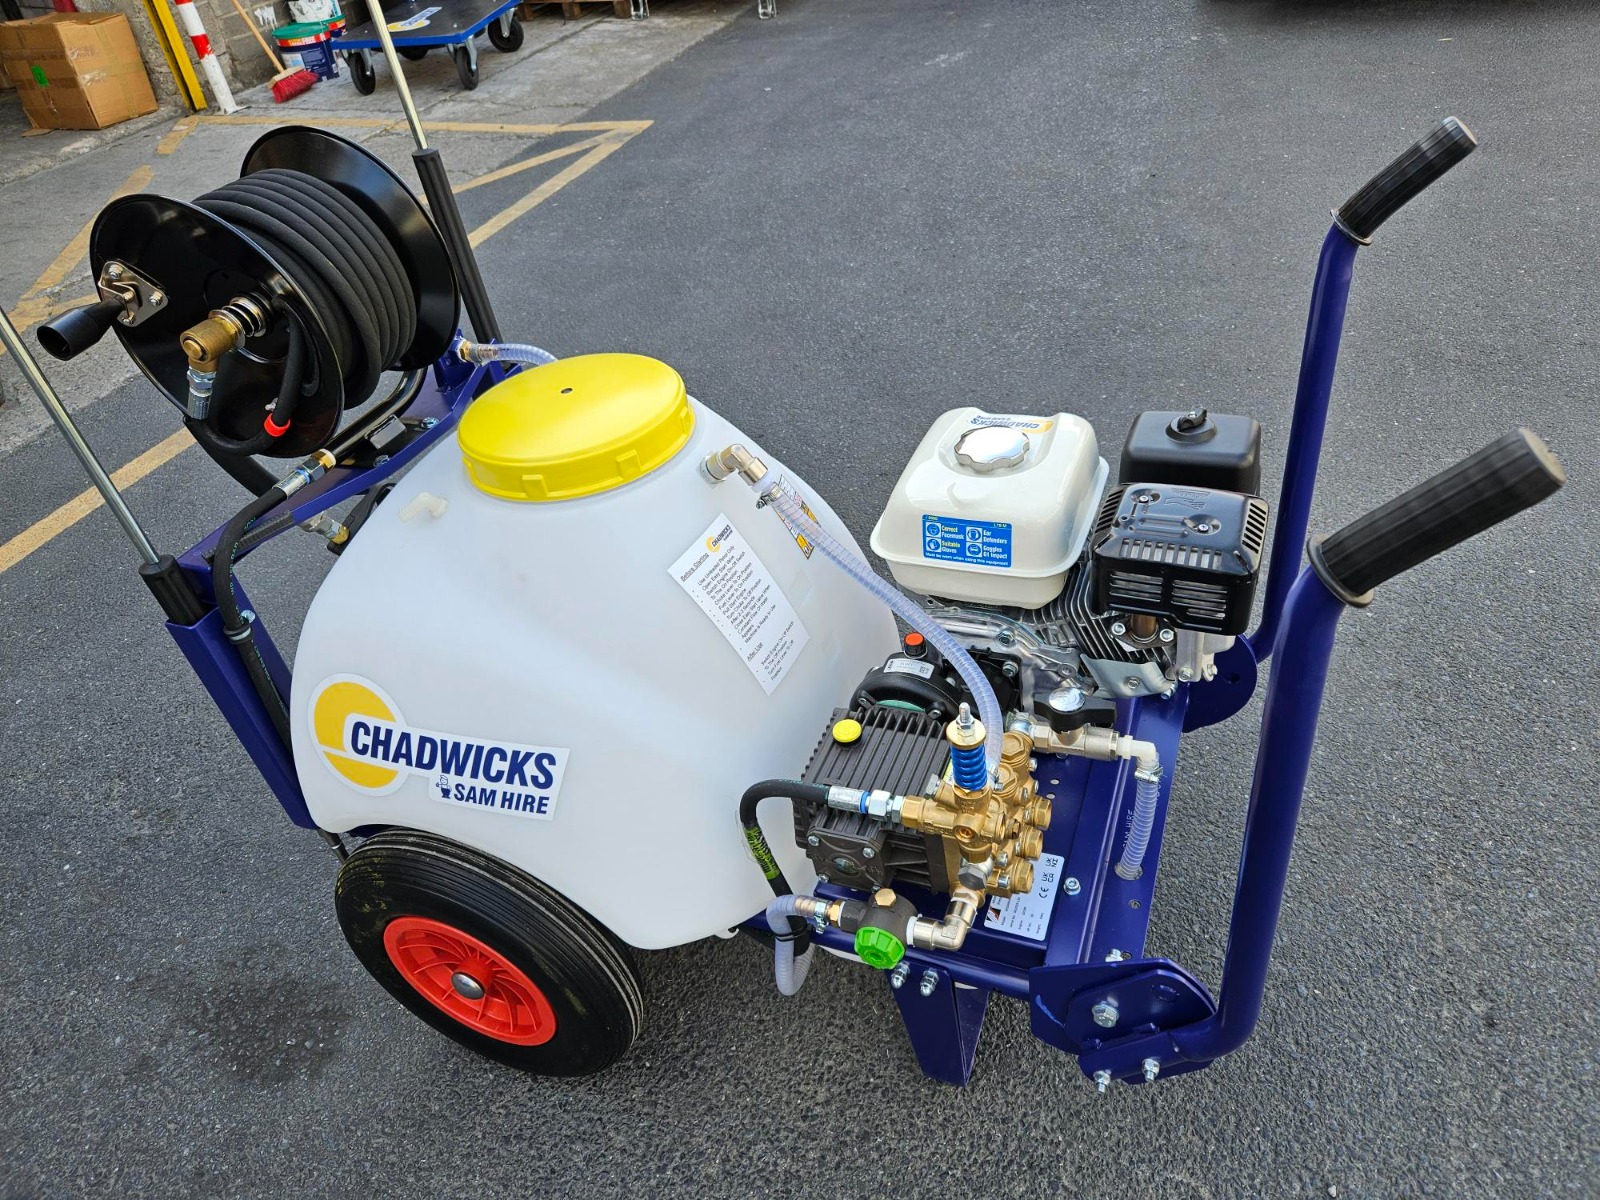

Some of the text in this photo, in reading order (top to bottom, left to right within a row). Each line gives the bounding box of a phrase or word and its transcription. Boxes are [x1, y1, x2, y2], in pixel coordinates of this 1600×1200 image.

[971, 418, 1041, 429] CHADWICKS
[942, 532, 964, 540] Facemask
[983, 536, 1007, 544] Defenders
[983, 545, 1002, 553] Goggles
[350, 720, 557, 790] CHADWICKS
[454, 782, 550, 815] SAM HIRE
[1046, 857, 1052, 866] UK
[1051, 858, 1058, 867] NI
[1042, 872, 1049, 881] UK
[1047, 873, 1054, 882] CA
